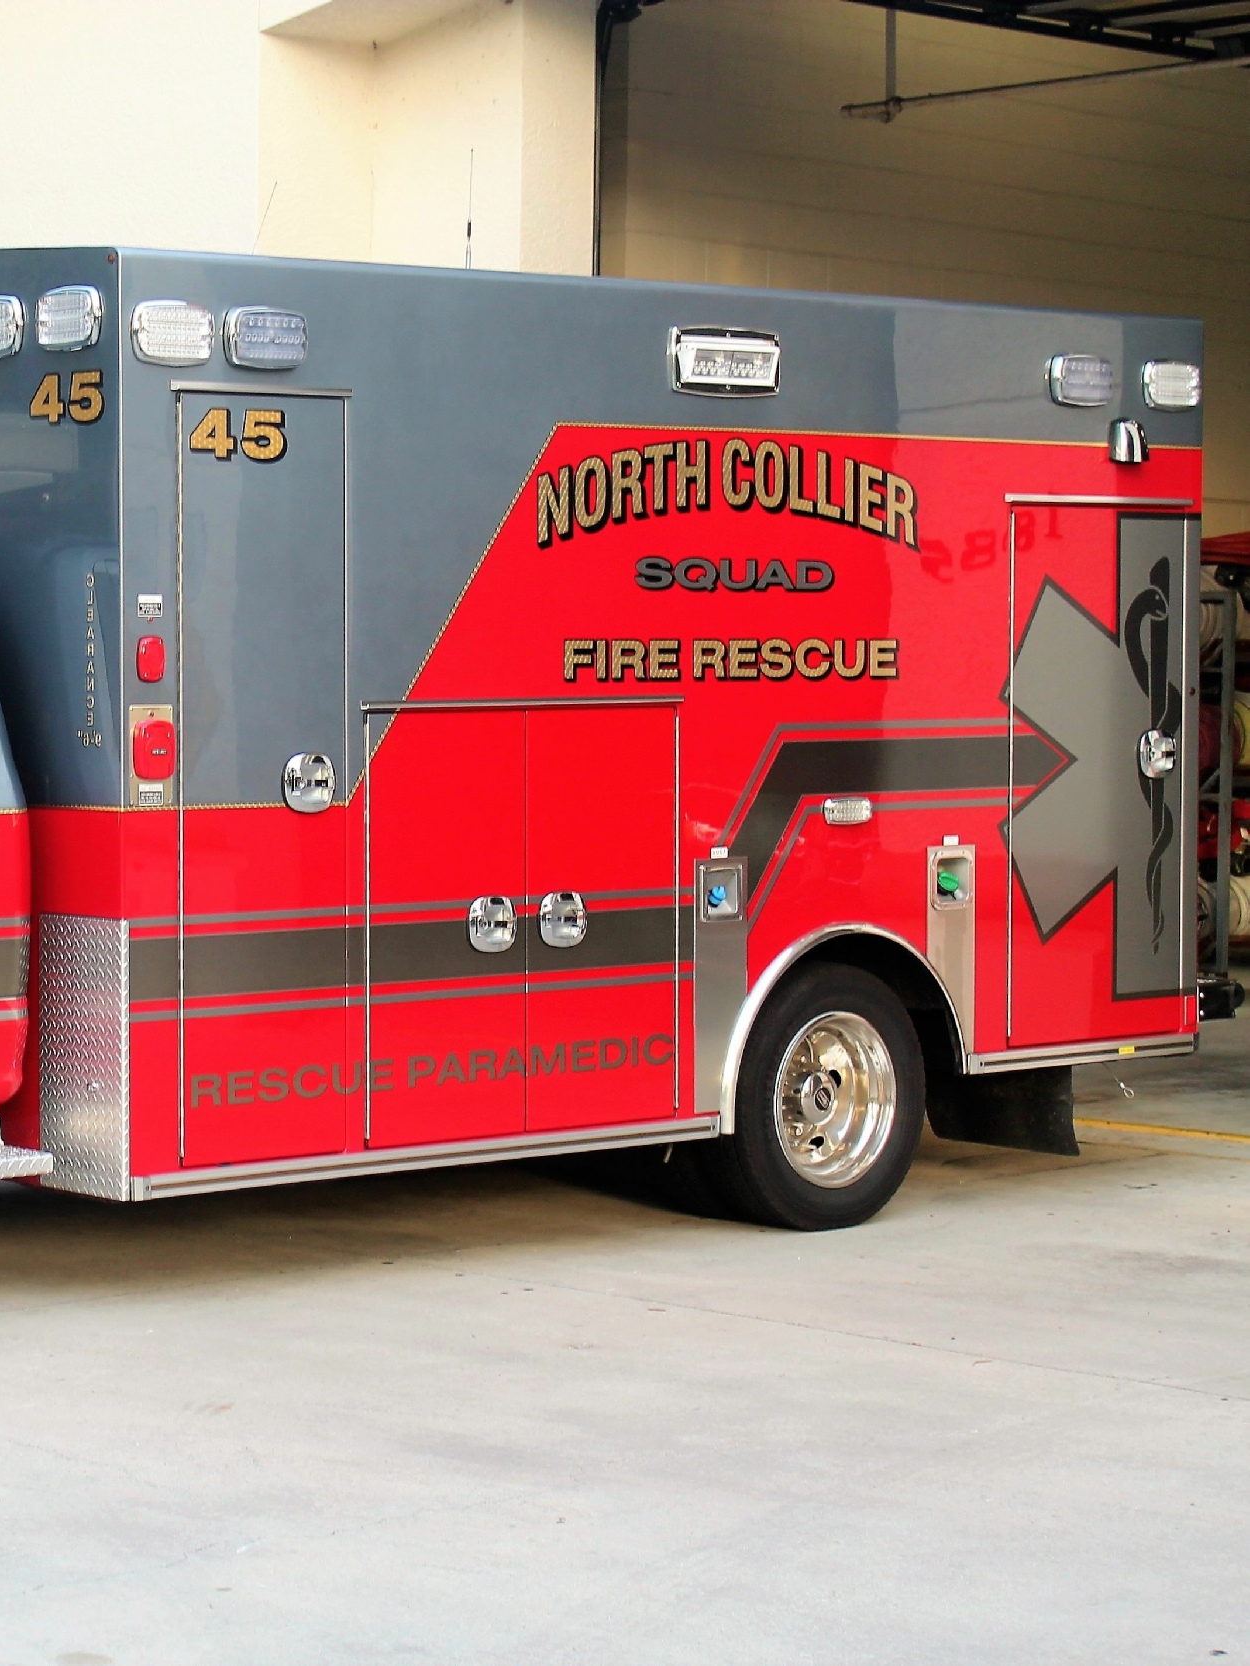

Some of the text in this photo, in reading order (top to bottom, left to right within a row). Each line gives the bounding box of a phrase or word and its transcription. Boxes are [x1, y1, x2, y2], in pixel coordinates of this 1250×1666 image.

[29, 370, 106, 425] 45
[188, 407, 288, 463] 45
[536, 436, 921, 553] NORTH COLLIER
[634, 556, 835, 593] SQUAD
[563, 637, 900, 682] FIRE RESCUE
[190, 1033, 674, 1109] RESCUE PARAMEDIC
